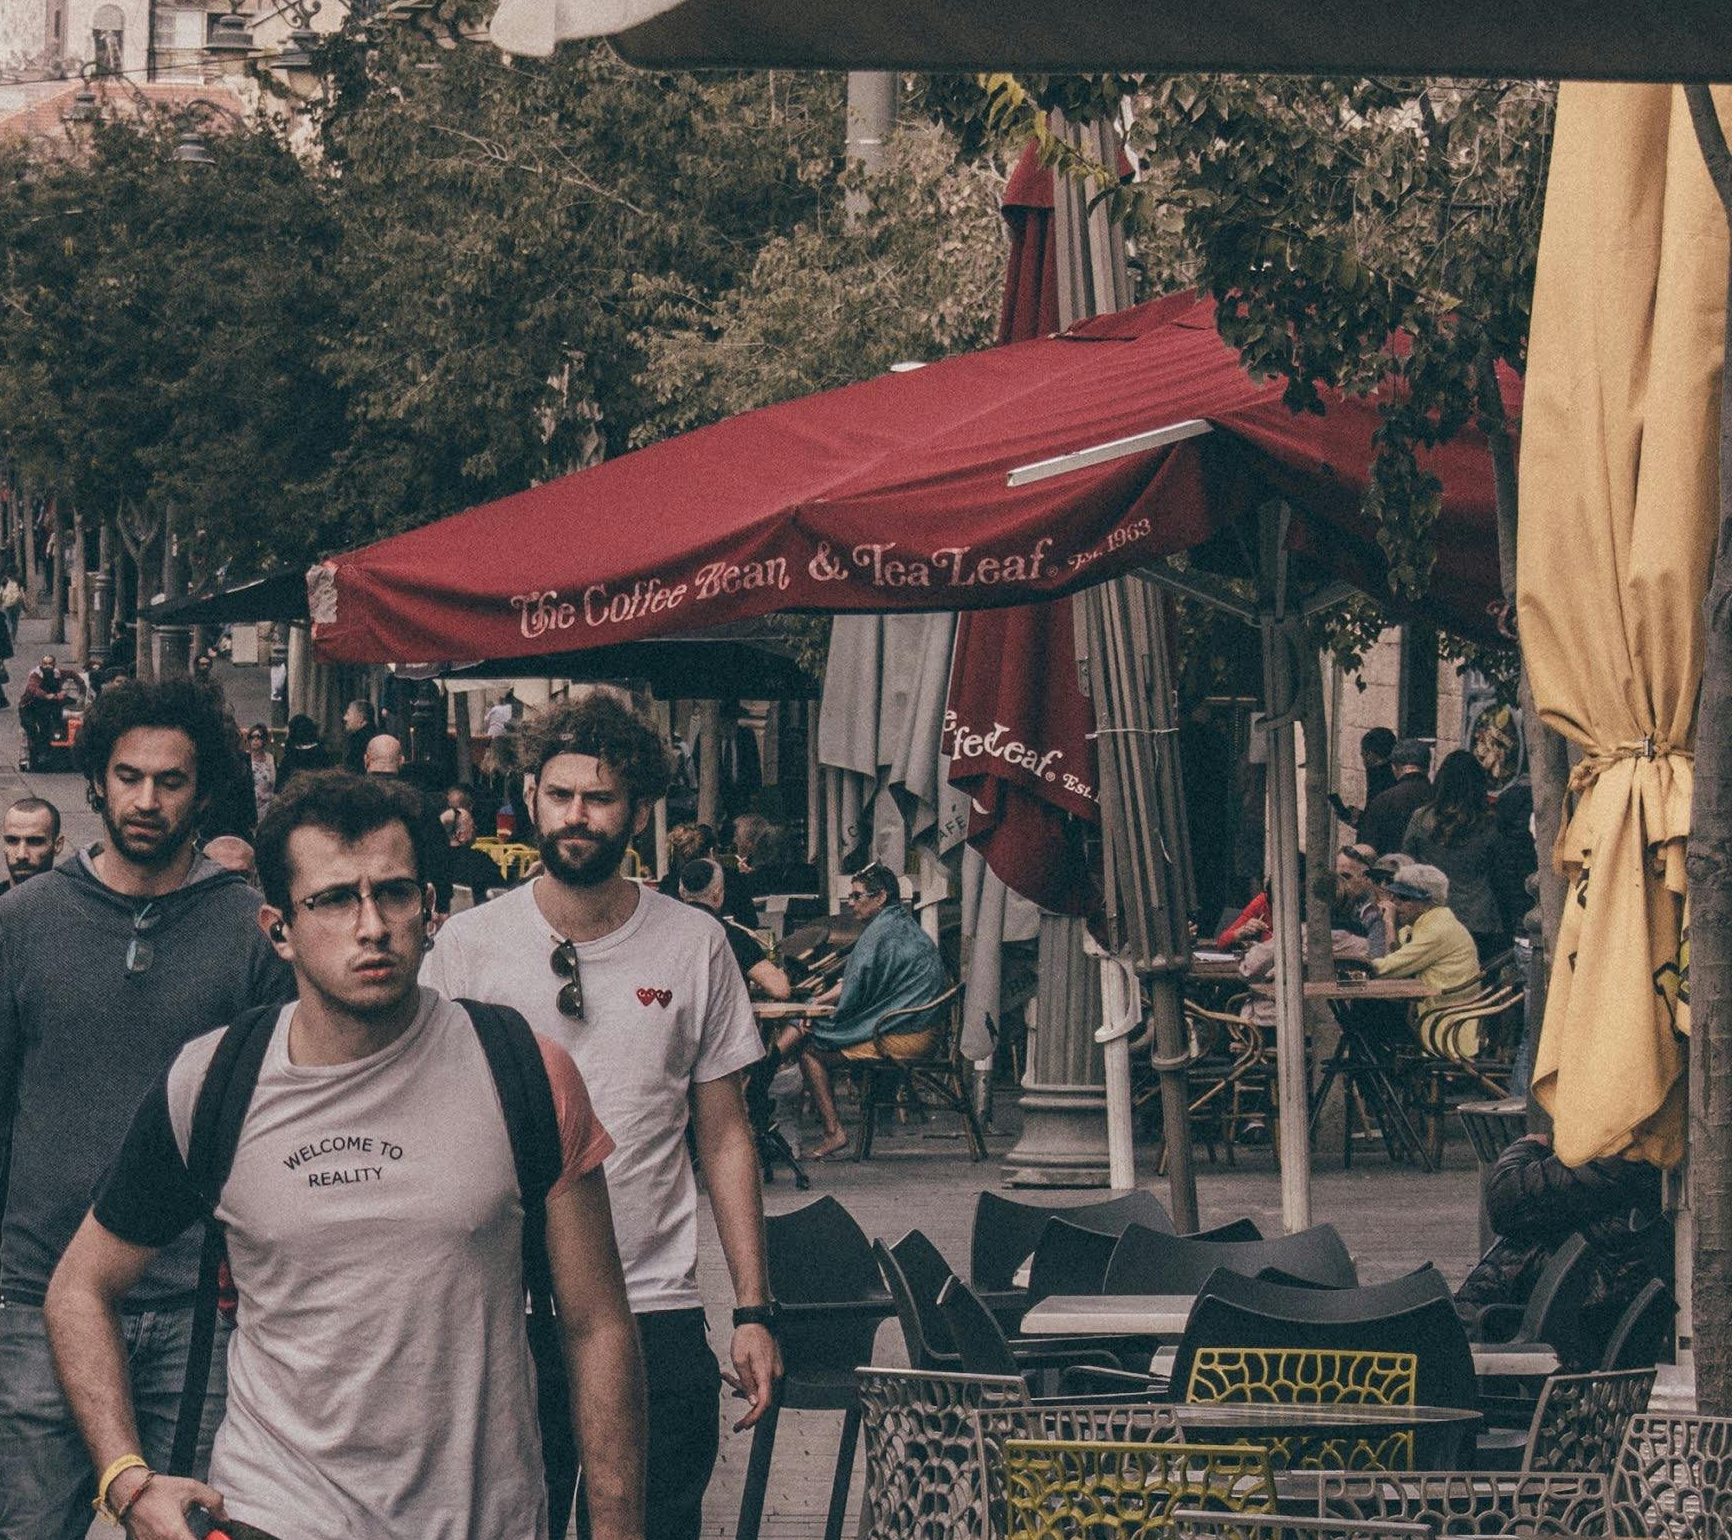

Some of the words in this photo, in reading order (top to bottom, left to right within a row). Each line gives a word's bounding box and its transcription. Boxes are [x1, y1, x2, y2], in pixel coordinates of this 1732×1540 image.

[510, 590, 576, 639] The
[583, 577, 688, 627] Coffee
[695, 557, 790, 600] Bean
[807, 541, 849, 582] &
[852, 542, 930, 587] Tea
[1106, 517, 1152, 553] 1963
[282, 1135, 373, 1171] WELCOME
[380, 1141, 404, 1161] TO
[307, 1166, 384, 1188] REALITY
